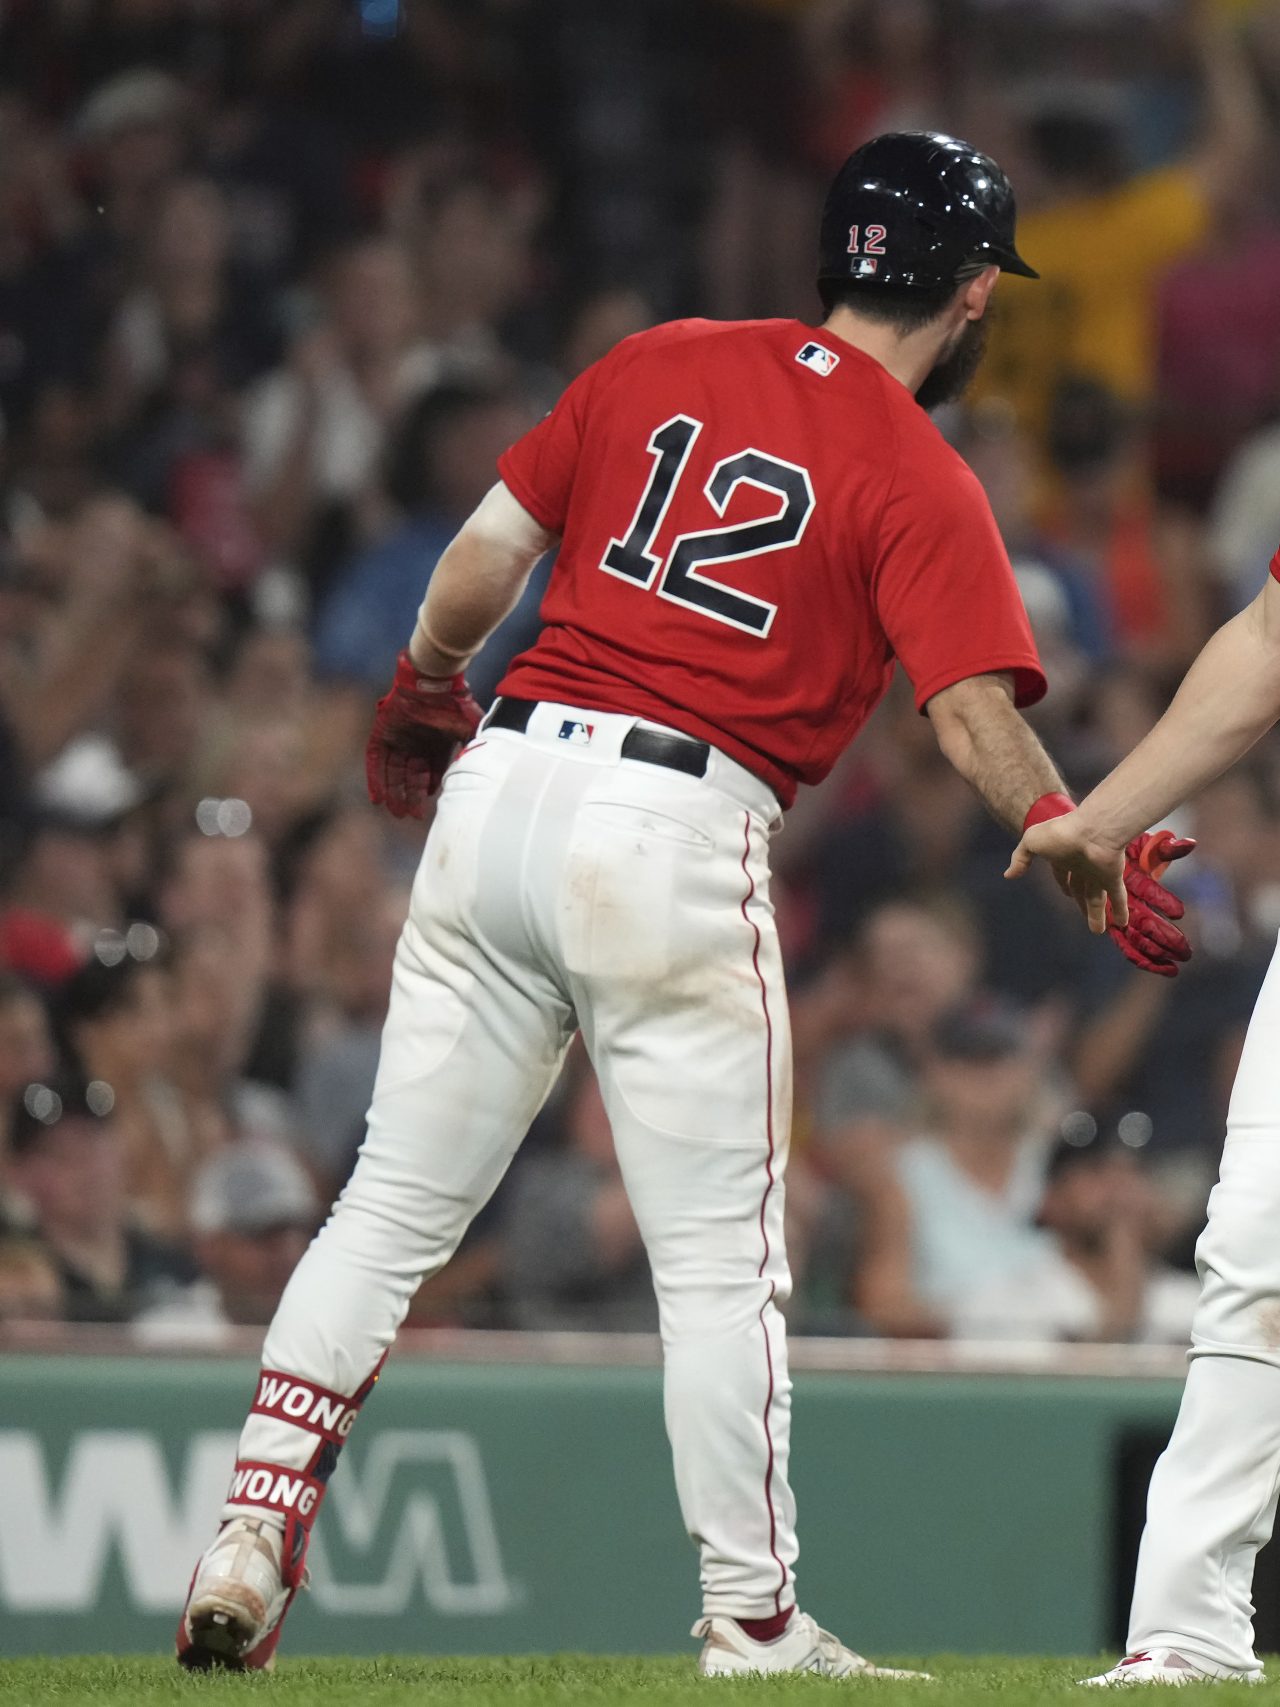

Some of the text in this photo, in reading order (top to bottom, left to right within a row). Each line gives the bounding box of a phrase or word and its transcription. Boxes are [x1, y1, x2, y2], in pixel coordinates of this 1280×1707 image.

[847, 224, 887, 255] 12
[598, 413, 817, 640] 12
[257, 1376, 358, 1437] WONG
